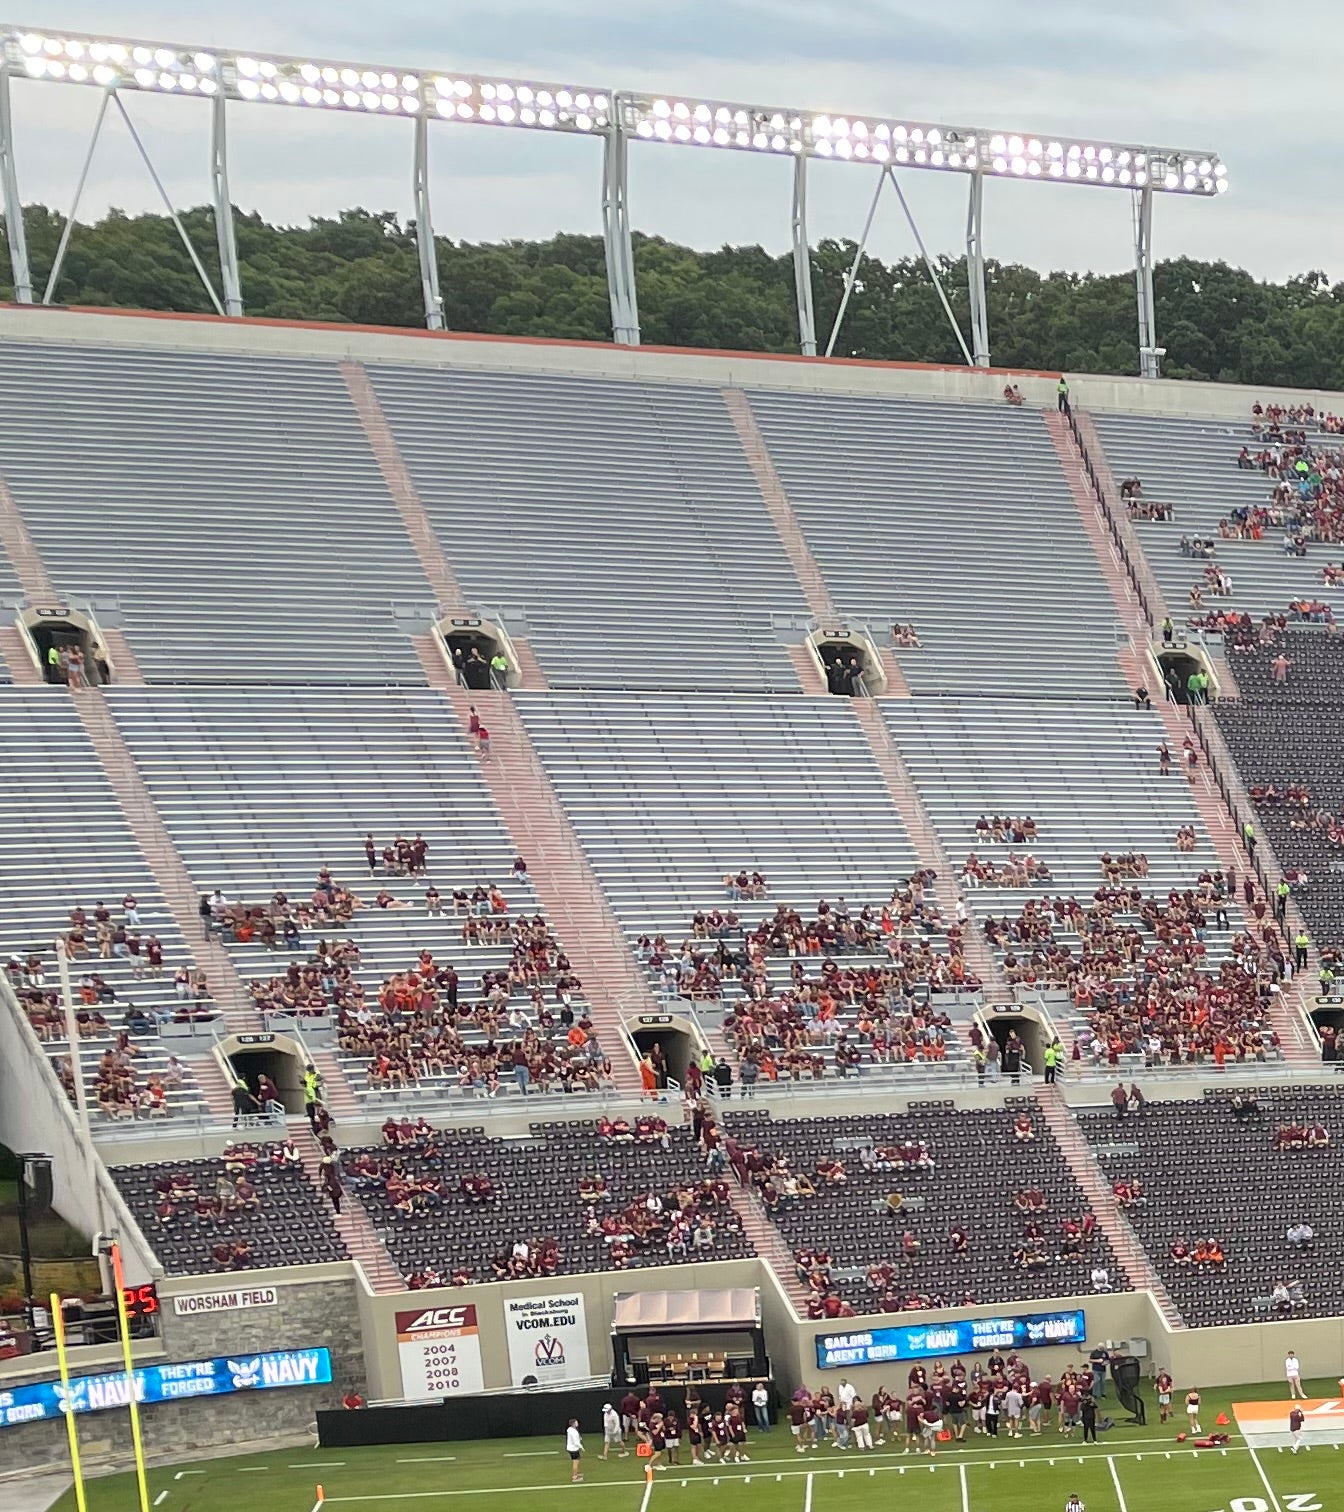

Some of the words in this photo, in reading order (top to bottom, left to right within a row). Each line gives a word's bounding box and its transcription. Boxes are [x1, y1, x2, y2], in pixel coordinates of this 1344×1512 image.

[177, 1293, 238, 1312] WORSHAM
[242, 1290, 275, 1306] FIELD
[509, 1299, 547, 1312] Medical
[548, 1297, 579, 1308] School
[404, 1307, 467, 1332] ACC
[515, 1315, 577, 1331] VCOM.EDU
[971, 1320, 1015, 1334] THEY'RE
[926, 1331, 959, 1350] NAVY
[423, 1344, 455, 1356] 2004
[825, 1349, 865, 1364] AREN'T
[158, 1361, 215, 1379] THEY'RE
[262, 1355, 320, 1384] NAVY
[424, 1356, 457, 1368] 2007
[425, 1368, 458, 1379] 2008
[88, 1376, 145, 1409] NAVY
[161, 1378, 215, 1396] FORGED
[427, 1379, 460, 1391] 2010
[7, 1402, 46, 1419] BORN
